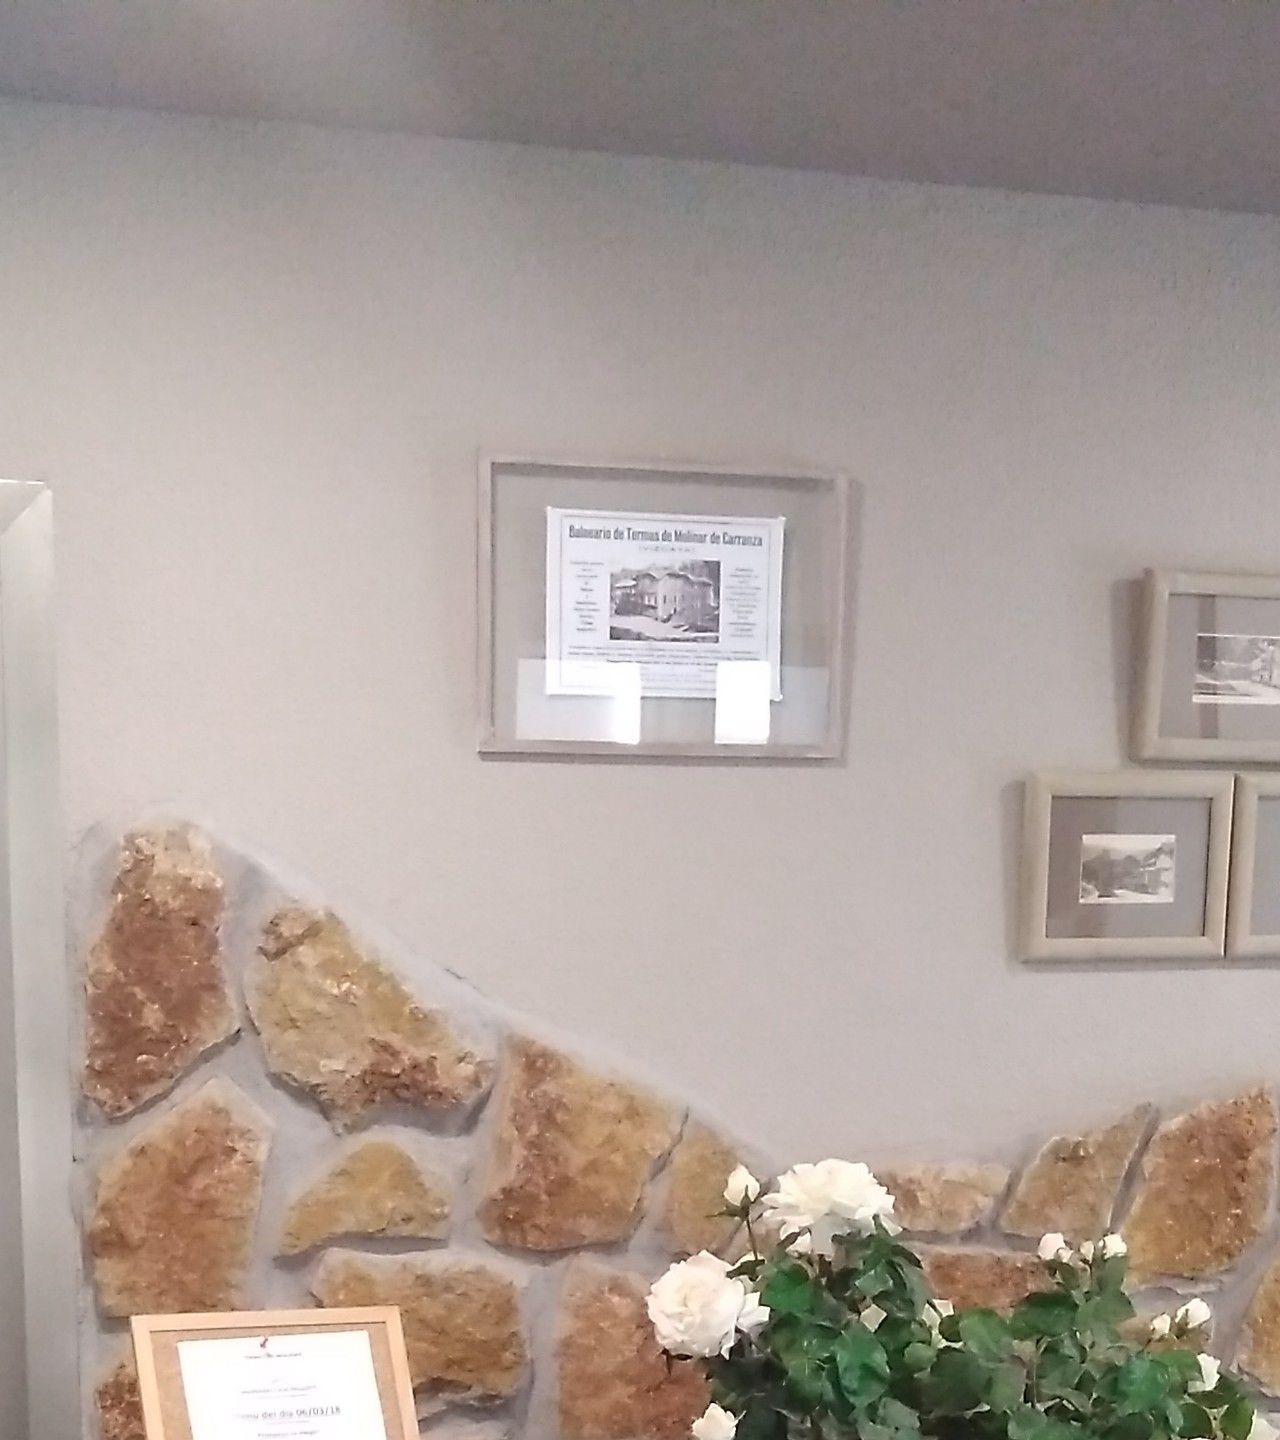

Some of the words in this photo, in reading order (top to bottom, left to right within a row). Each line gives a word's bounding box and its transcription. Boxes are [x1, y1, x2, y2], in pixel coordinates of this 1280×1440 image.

[613, 526, 624, 540] de
[661, 528, 672, 542] de
[710, 531, 721, 545] de
[722, 531, 764, 547] Carranza
